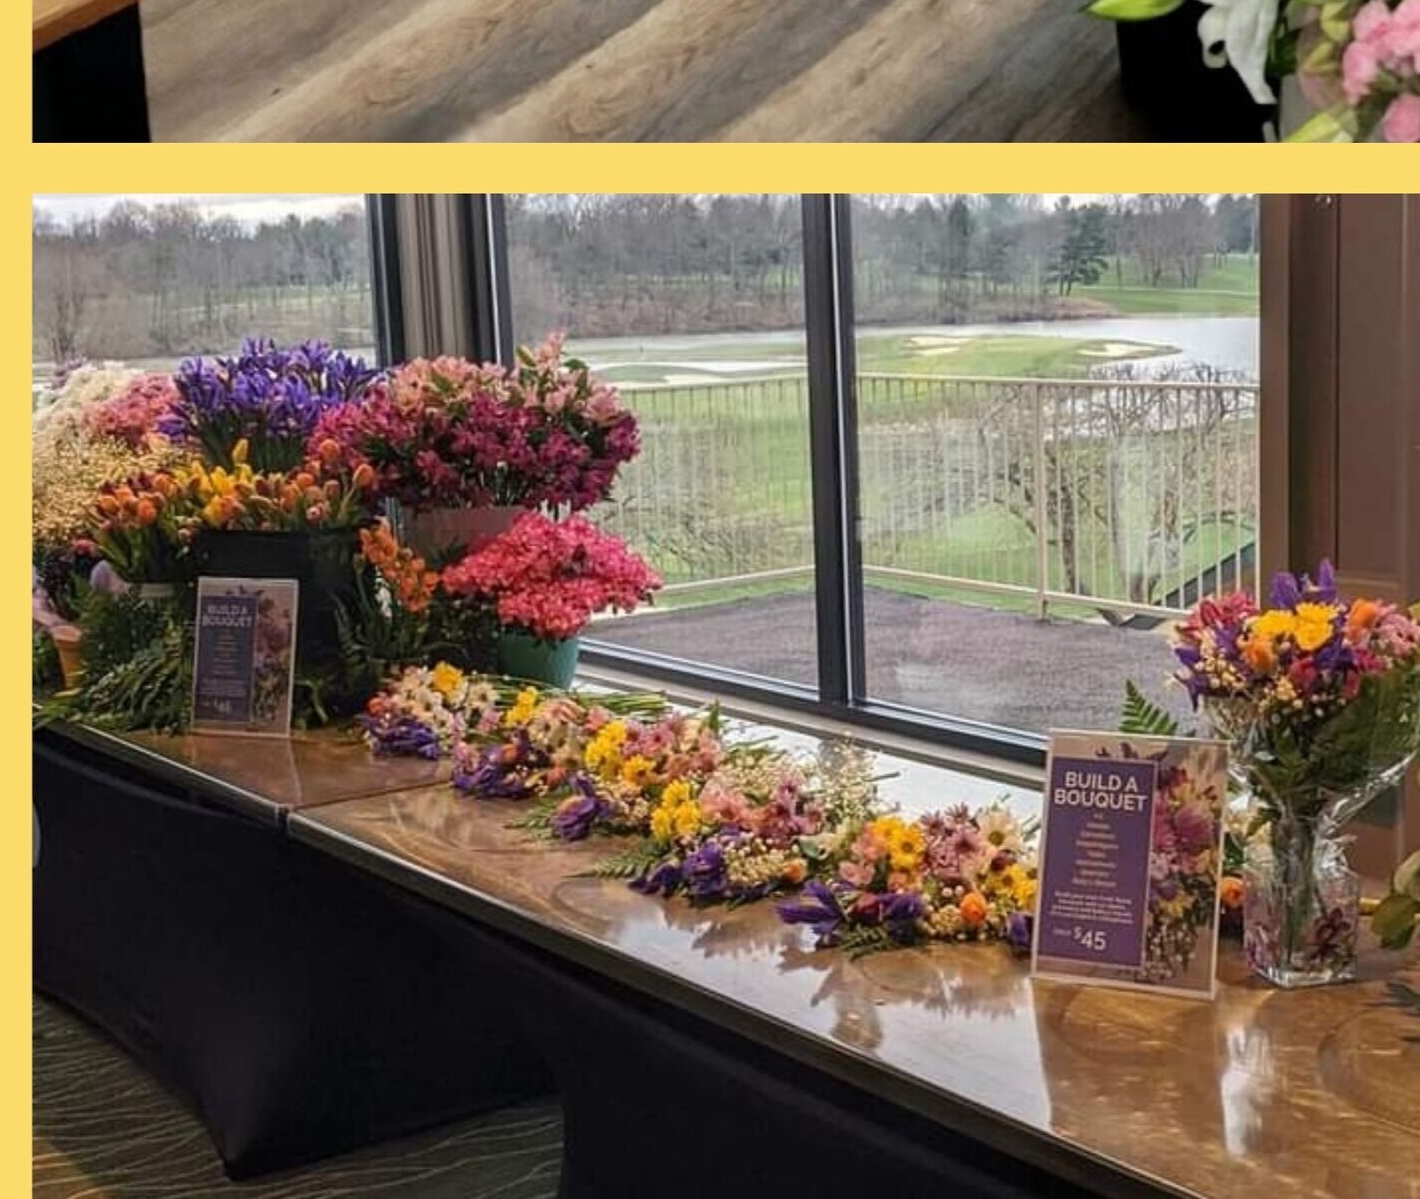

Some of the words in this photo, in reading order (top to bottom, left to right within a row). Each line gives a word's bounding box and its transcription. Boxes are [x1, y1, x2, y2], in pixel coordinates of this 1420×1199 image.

[1065, 770, 1121, 792] BUILD
[1124, 776, 1139, 793] A
[1054, 788, 1148, 812] BOUQUET
[1073, 926, 1107, 951] $45
